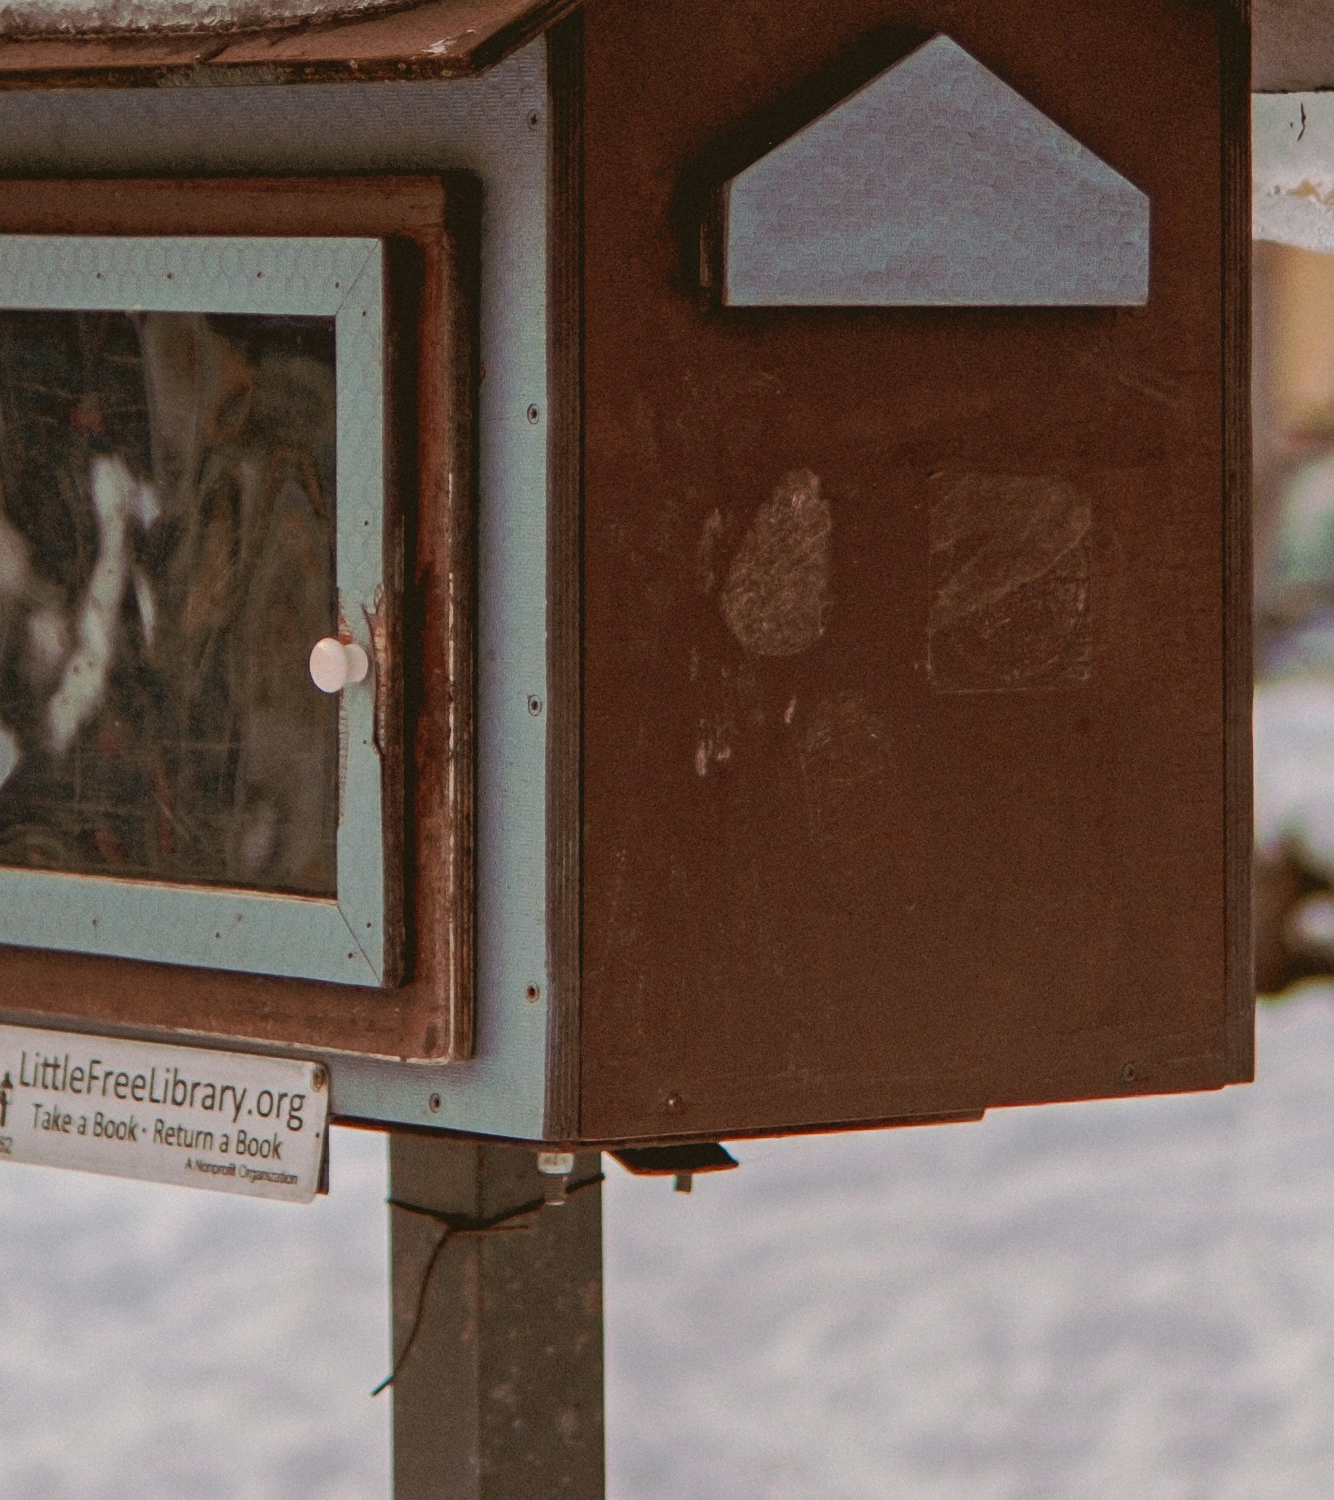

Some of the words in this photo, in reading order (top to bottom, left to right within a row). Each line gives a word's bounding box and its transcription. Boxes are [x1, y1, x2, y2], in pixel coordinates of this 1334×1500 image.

[18, 1049, 307, 1132] LittleFreeLibrary.org
[32, 1103, 72, 1133] Take
[77, 1117, 87, 1136] a
[92, 1110, 138, 1143] Book
[153, 1117, 214, 1149] Return
[219, 1133, 229, 1154] a
[235, 1128, 283, 1160] Book
